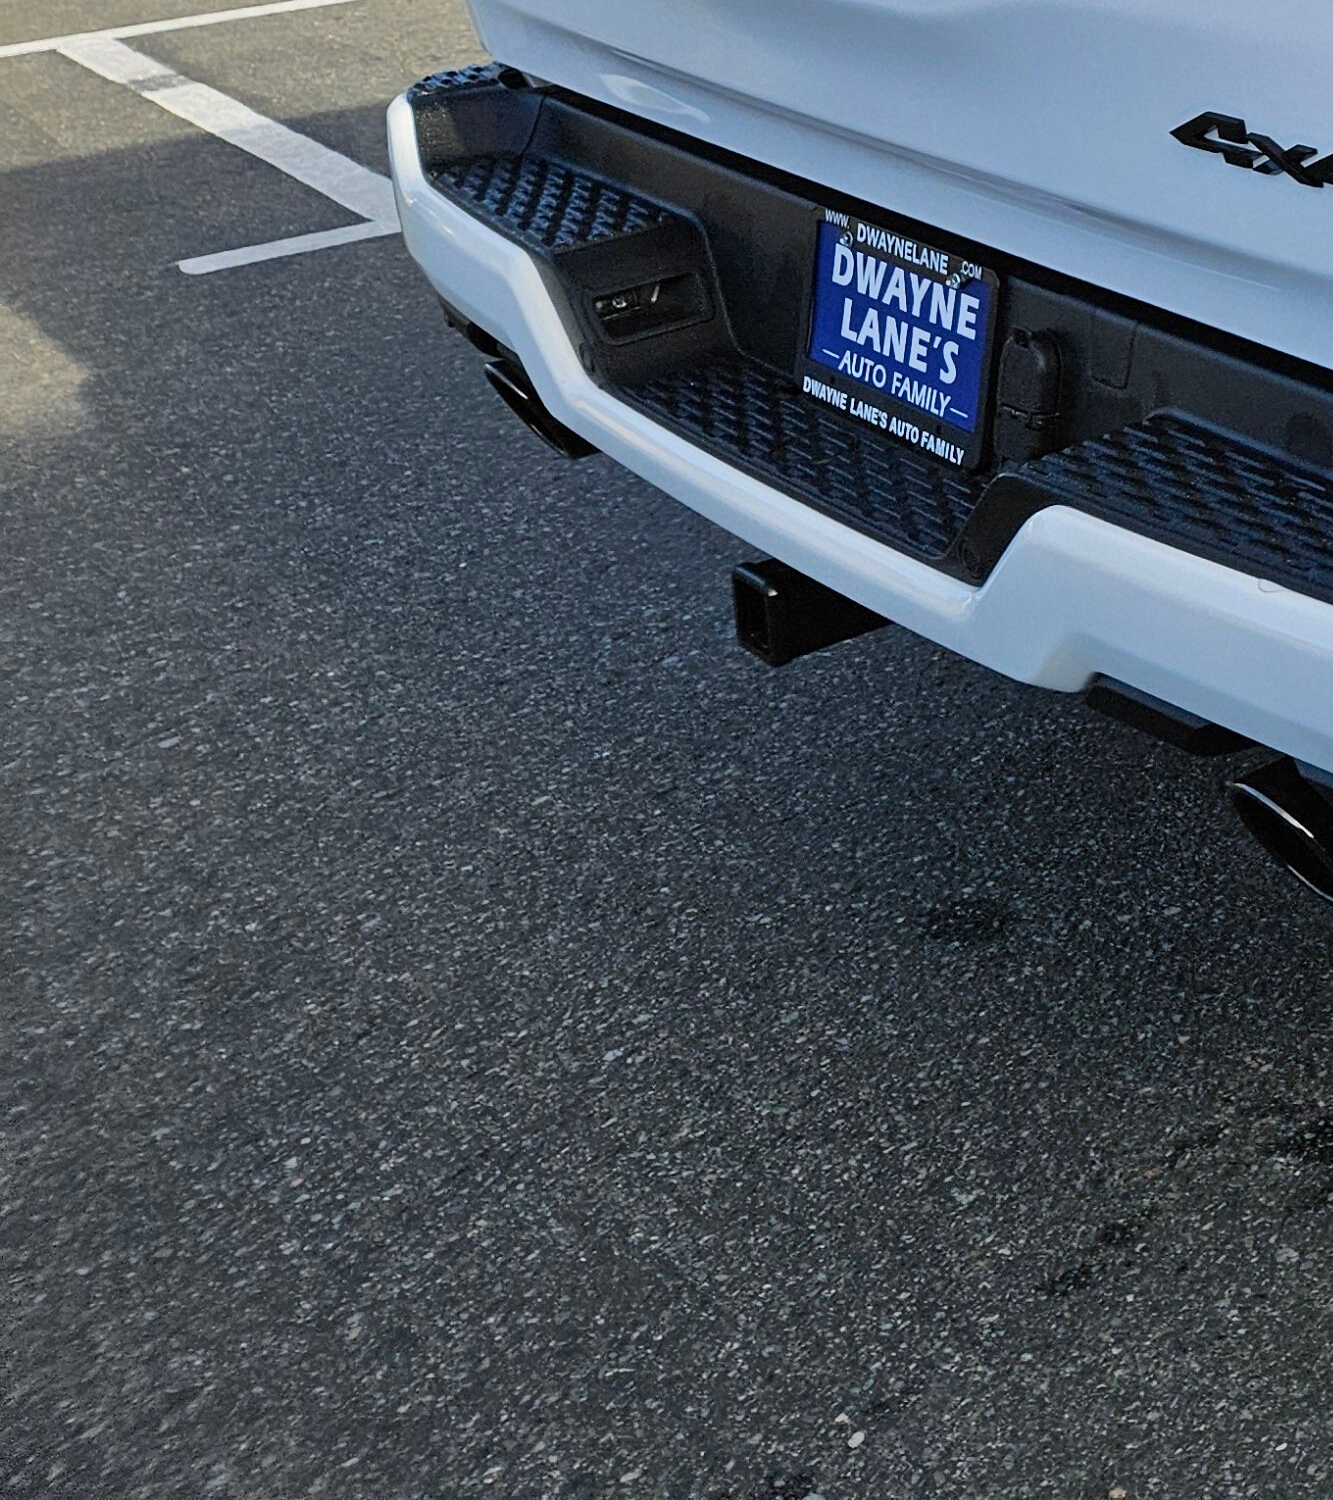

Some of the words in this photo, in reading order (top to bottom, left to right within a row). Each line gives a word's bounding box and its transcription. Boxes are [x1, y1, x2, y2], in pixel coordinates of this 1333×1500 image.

[831, 243, 980, 340] DWAYNE
[856, 223, 949, 275] DWAYNELANE
[838, 350, 887, 388] AUTO
[891, 372, 951, 418] FAMILY
[840, 297, 960, 385] LANE'S
[803, 376, 848, 411] DWAYNE
[850, 400, 888, 430] LANE'S
[889, 417, 919, 444] AUTO
[921, 431, 965, 466] FAMILY
